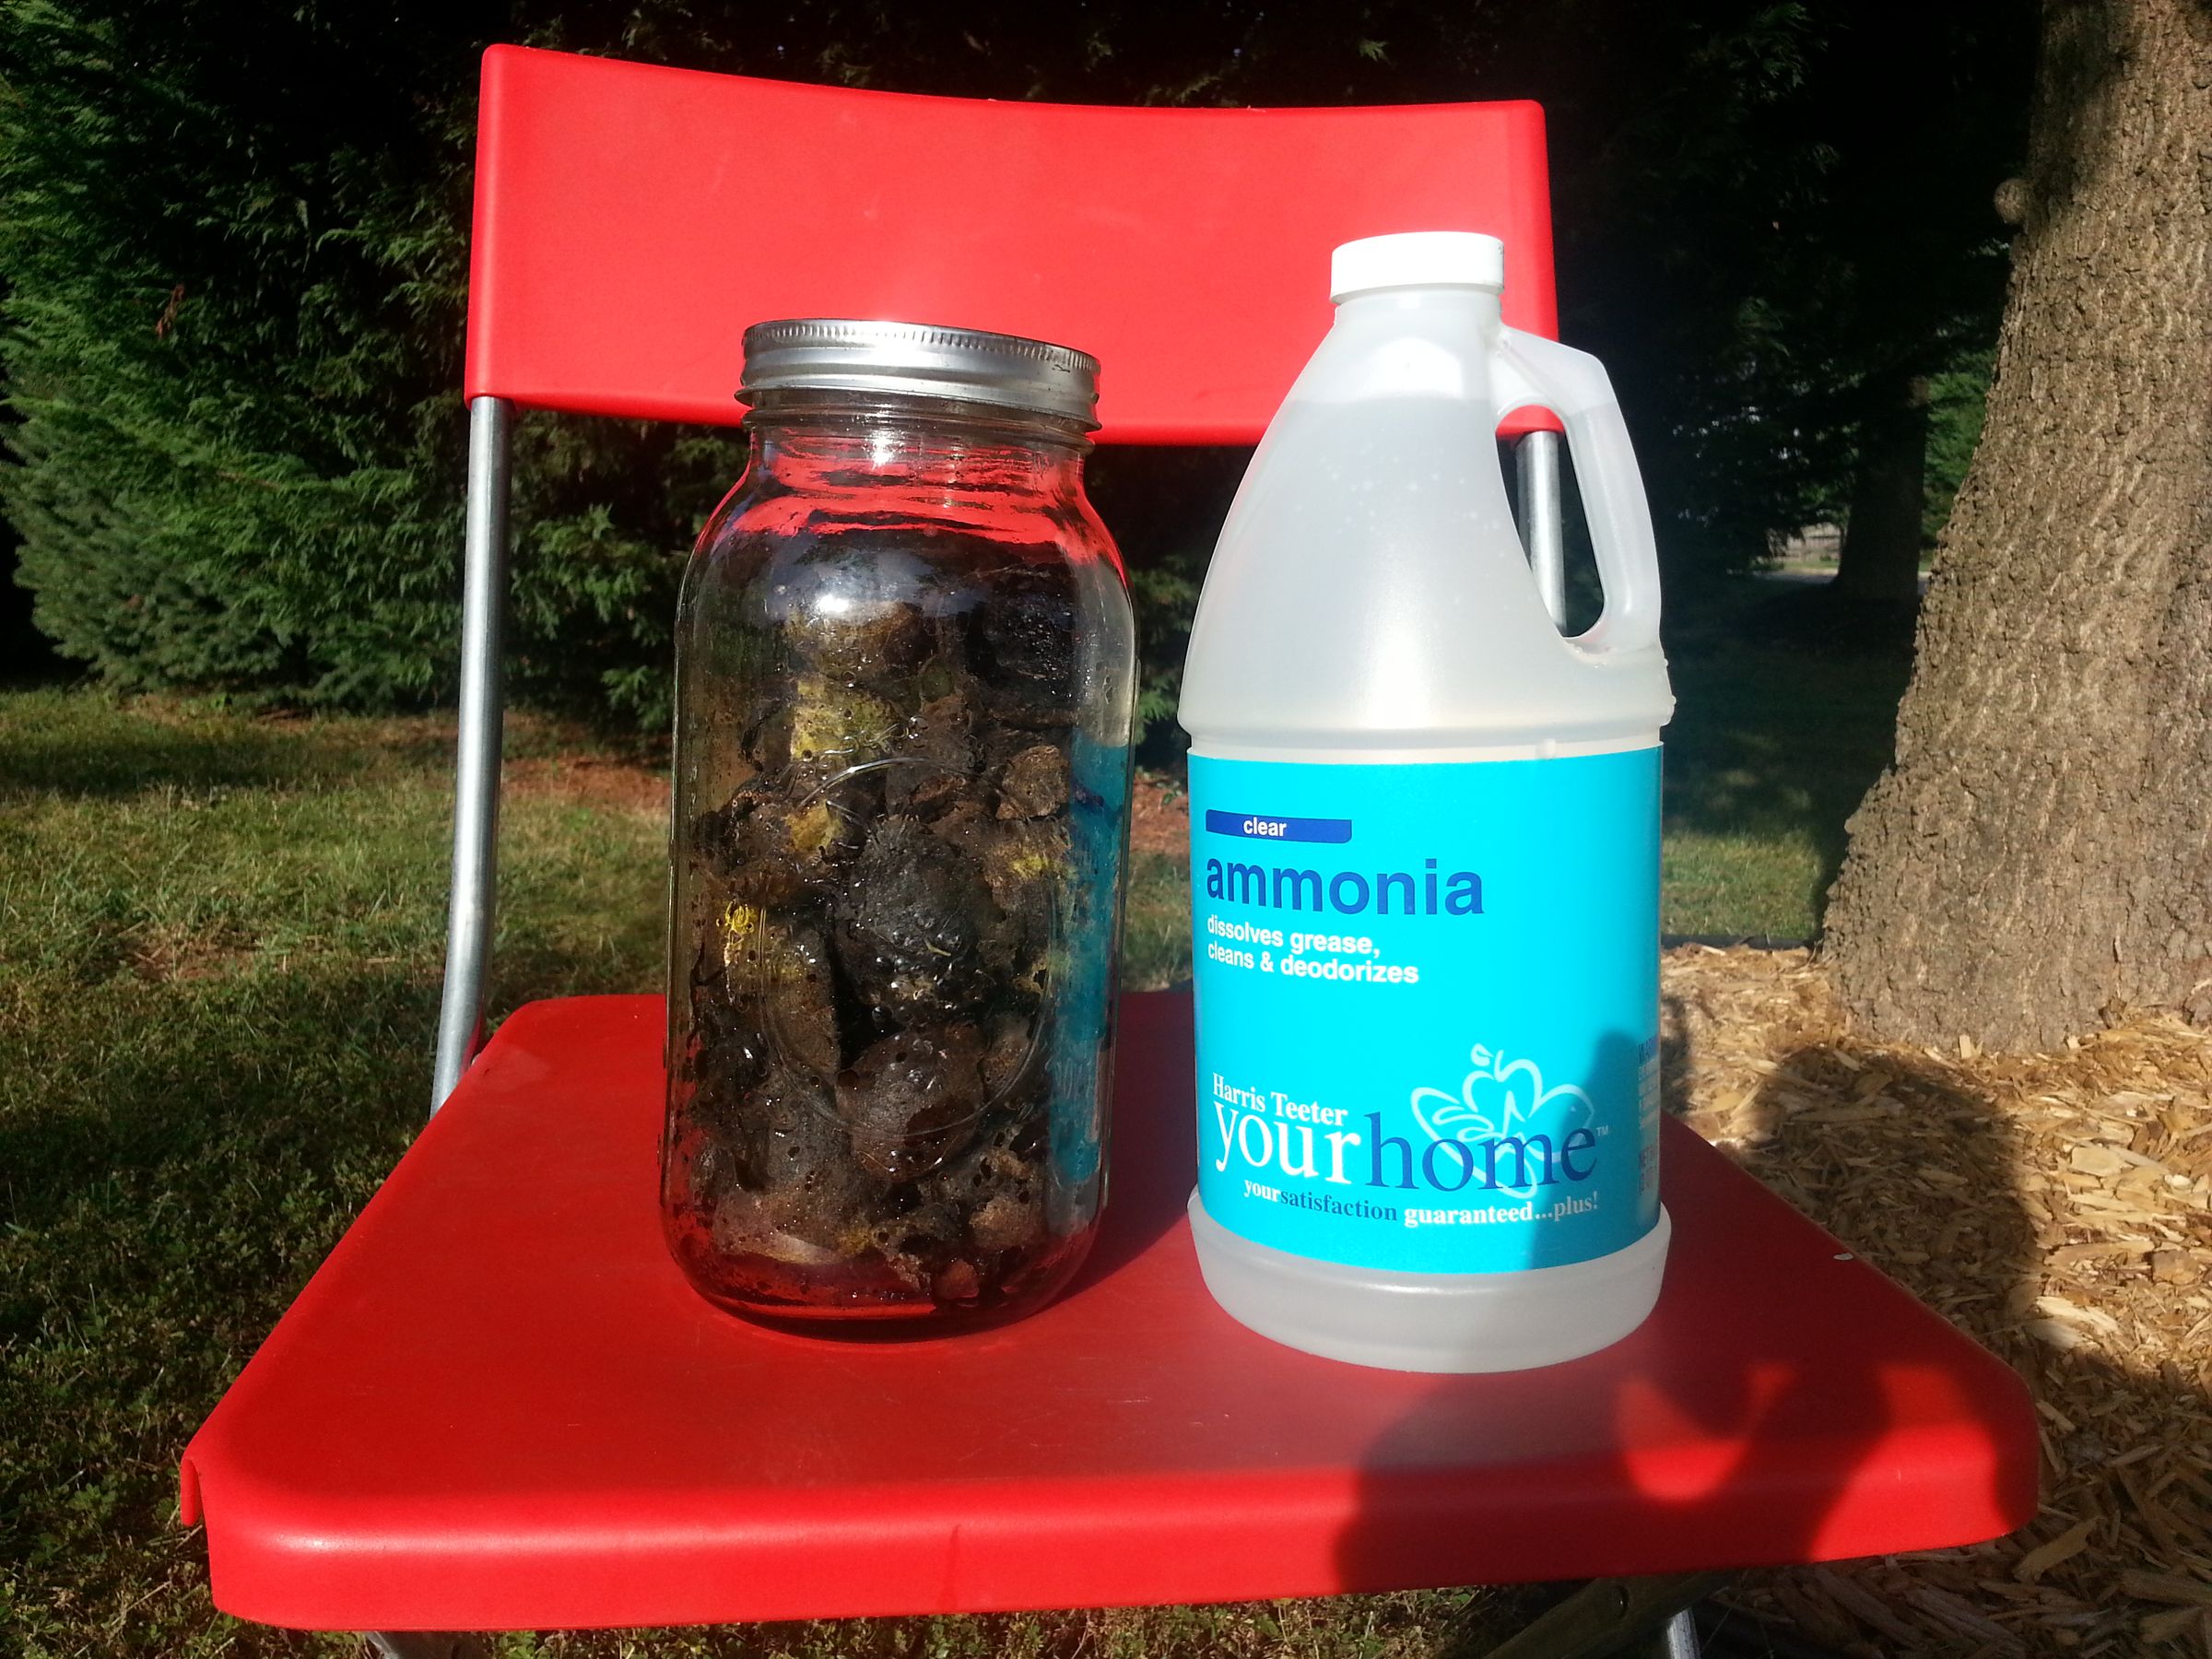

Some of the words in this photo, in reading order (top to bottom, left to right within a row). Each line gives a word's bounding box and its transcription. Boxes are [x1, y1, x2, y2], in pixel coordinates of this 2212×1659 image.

[1242, 817, 1288, 837] clear
[1206, 857, 1485, 916] ammonia
[1206, 914, 1284, 947] dissolves
[1290, 930, 1381, 959] grease,
[1207, 940, 1255, 970] cleans
[1259, 950, 1275, 973] &
[1279, 955, 1419, 984] deodorizes
[1212, 1072, 1266, 1113] Harris
[1270, 1091, 1349, 1127] Teeter
